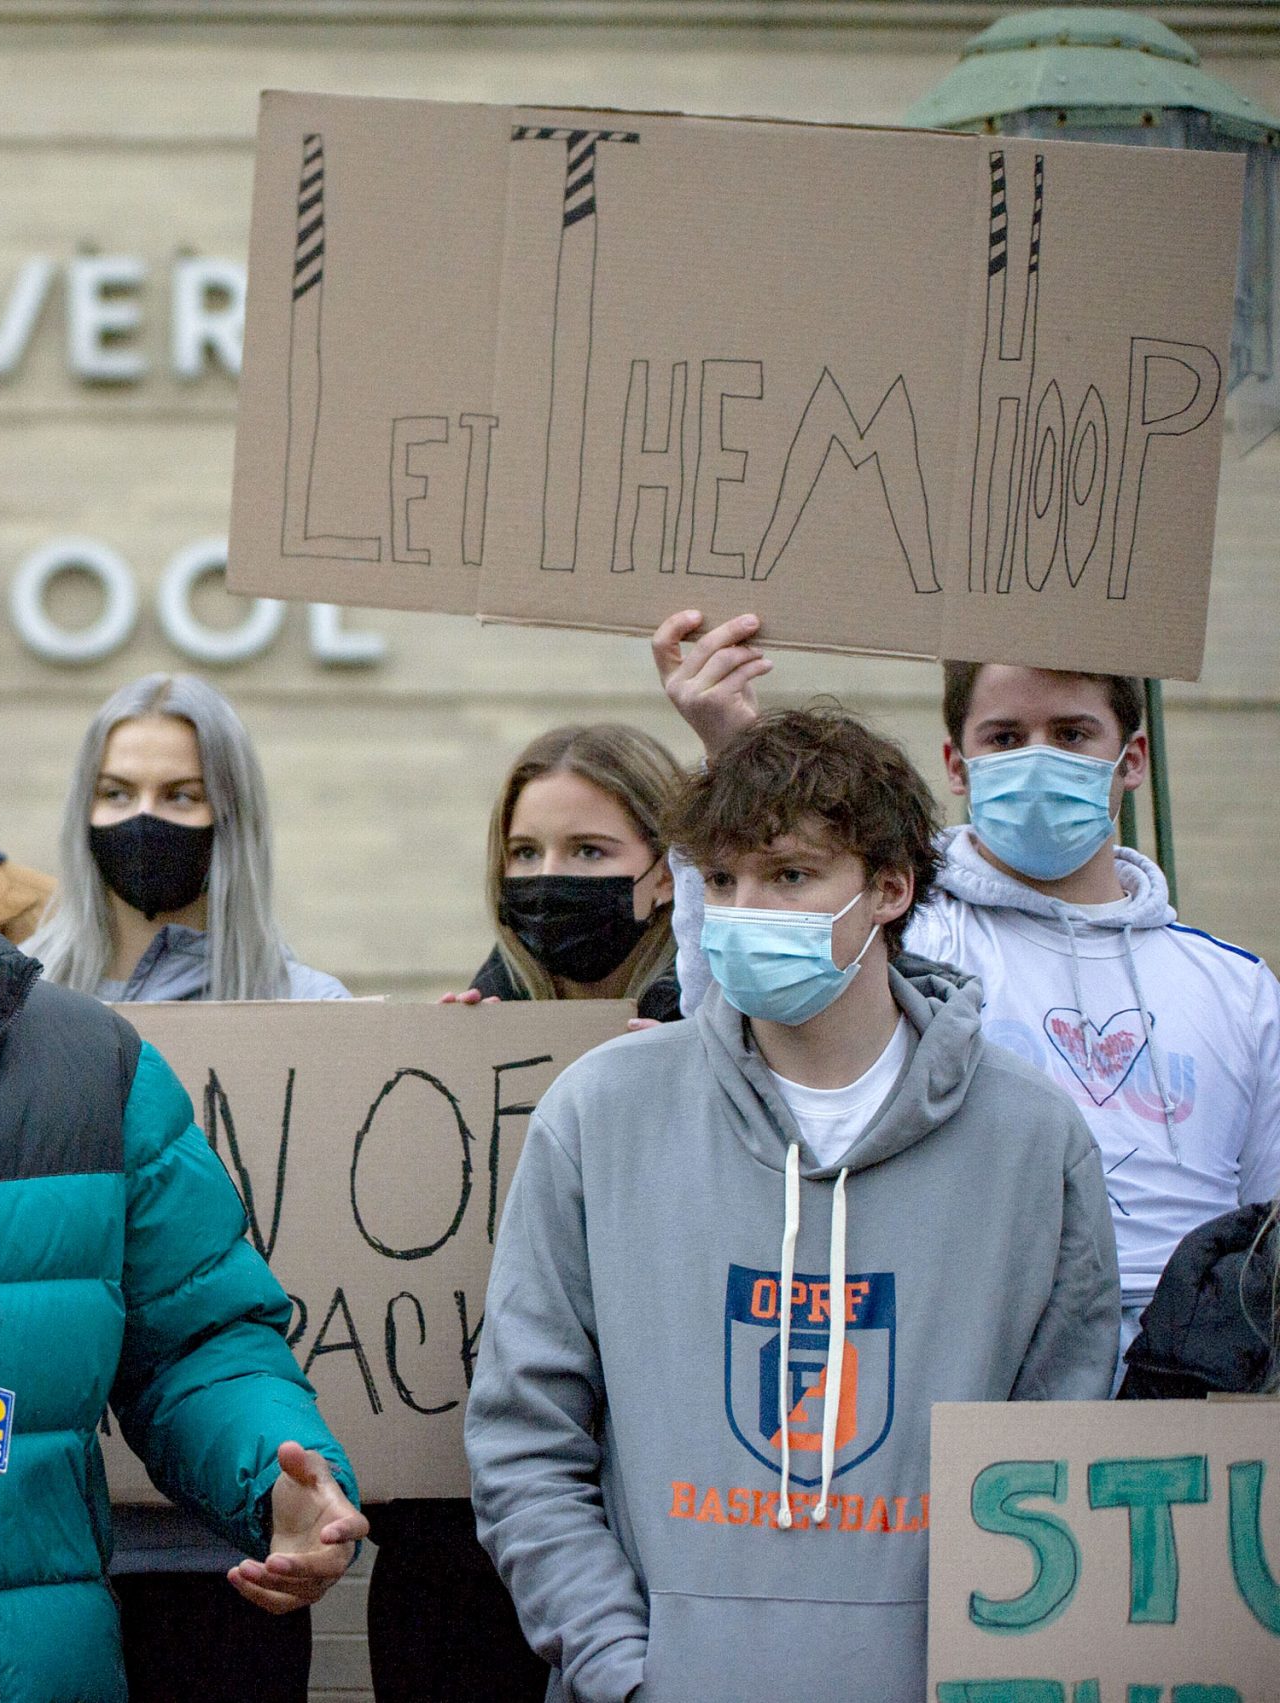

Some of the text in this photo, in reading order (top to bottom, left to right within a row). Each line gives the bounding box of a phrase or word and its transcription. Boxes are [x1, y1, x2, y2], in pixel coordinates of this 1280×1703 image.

[280, 126, 1222, 600] LET THEM HOOP
[351, 1054, 553, 1261] OF
[750, 1279, 870, 1323] OPRF
